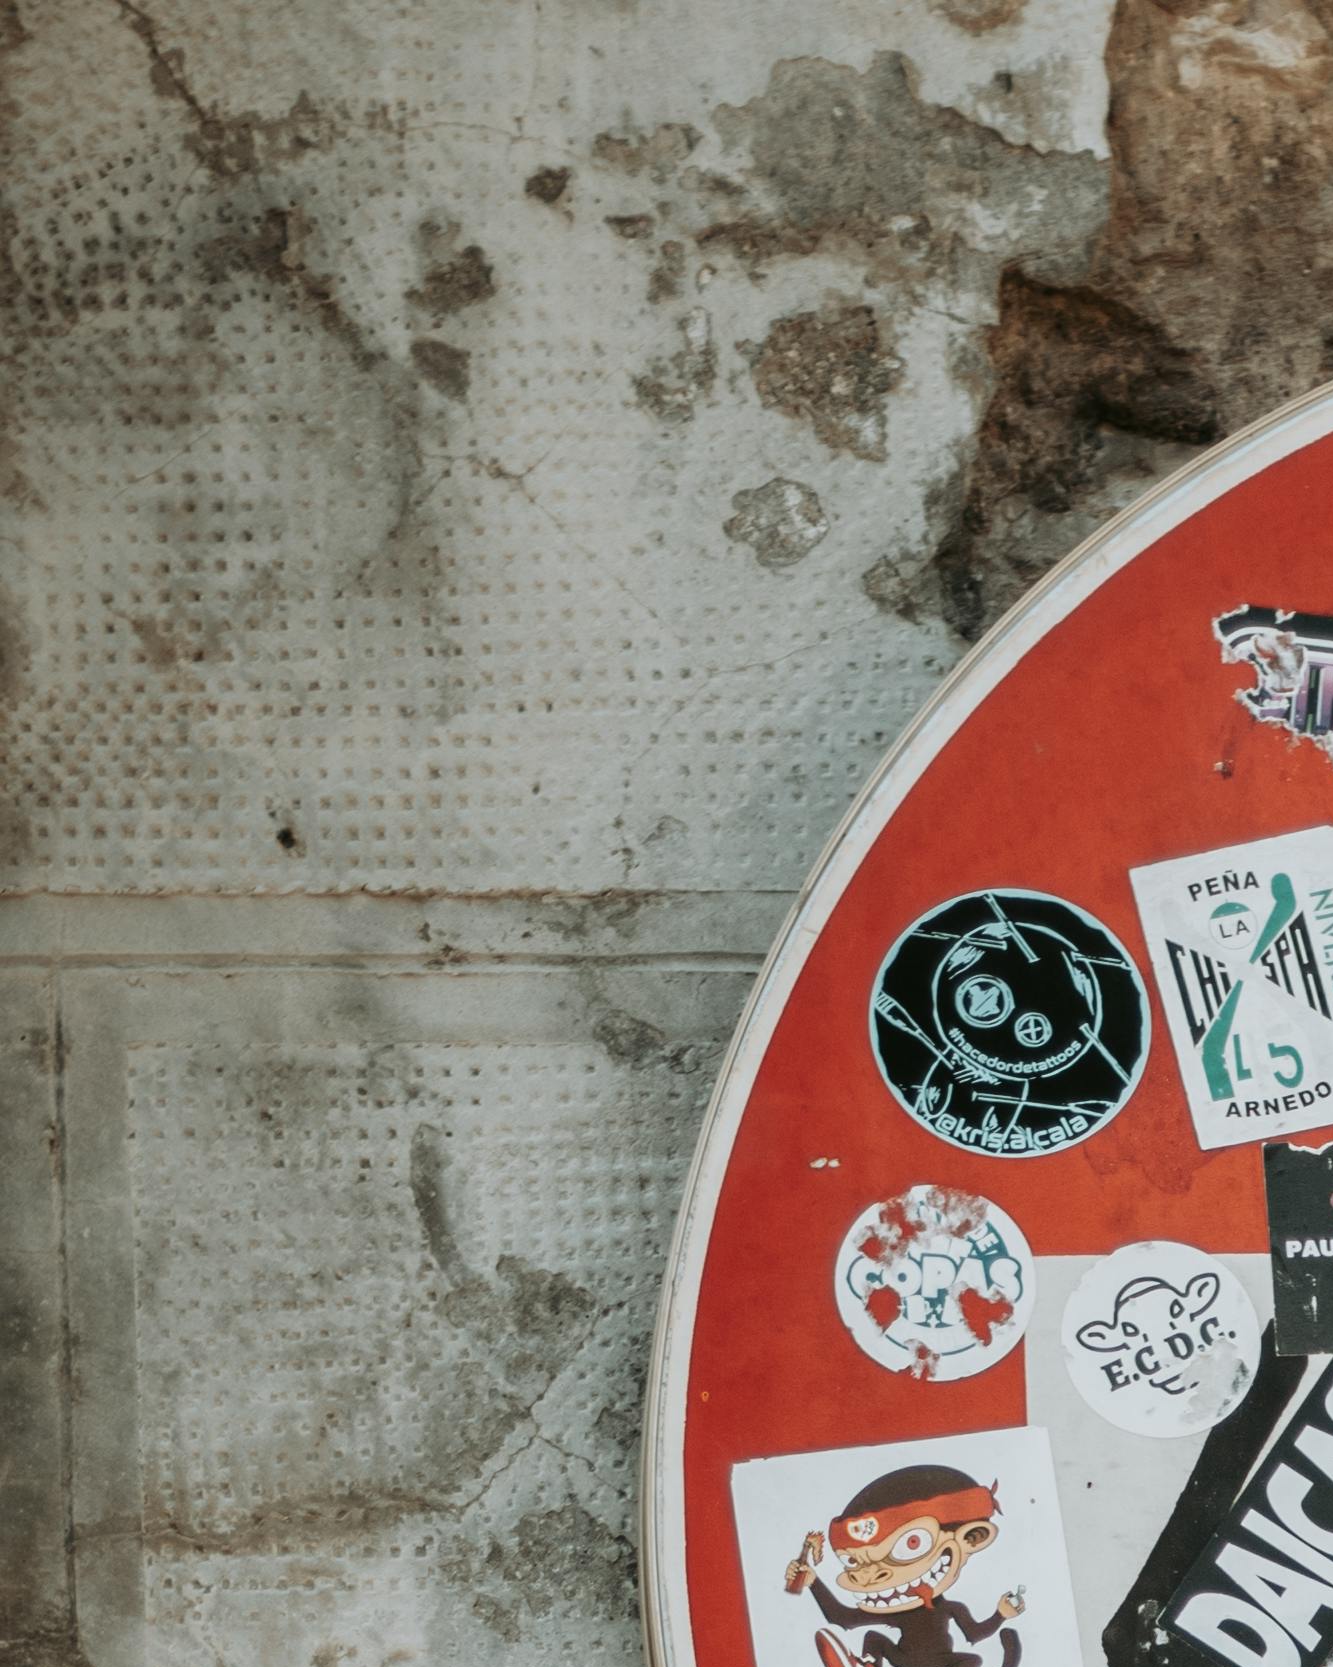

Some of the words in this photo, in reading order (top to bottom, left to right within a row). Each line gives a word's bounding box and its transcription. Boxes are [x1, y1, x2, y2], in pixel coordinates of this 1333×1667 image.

[1187, 870, 1260, 901] PEÑA
[1219, 920, 1250, 939] LA
[946, 1026, 1083, 1075] #hacedordetattoos
[1226, 1080, 1332, 1118] ARNEDO
[936, 1110, 1091, 1152] @kris.alcala
[847, 1253, 1023, 1304] COPAS
